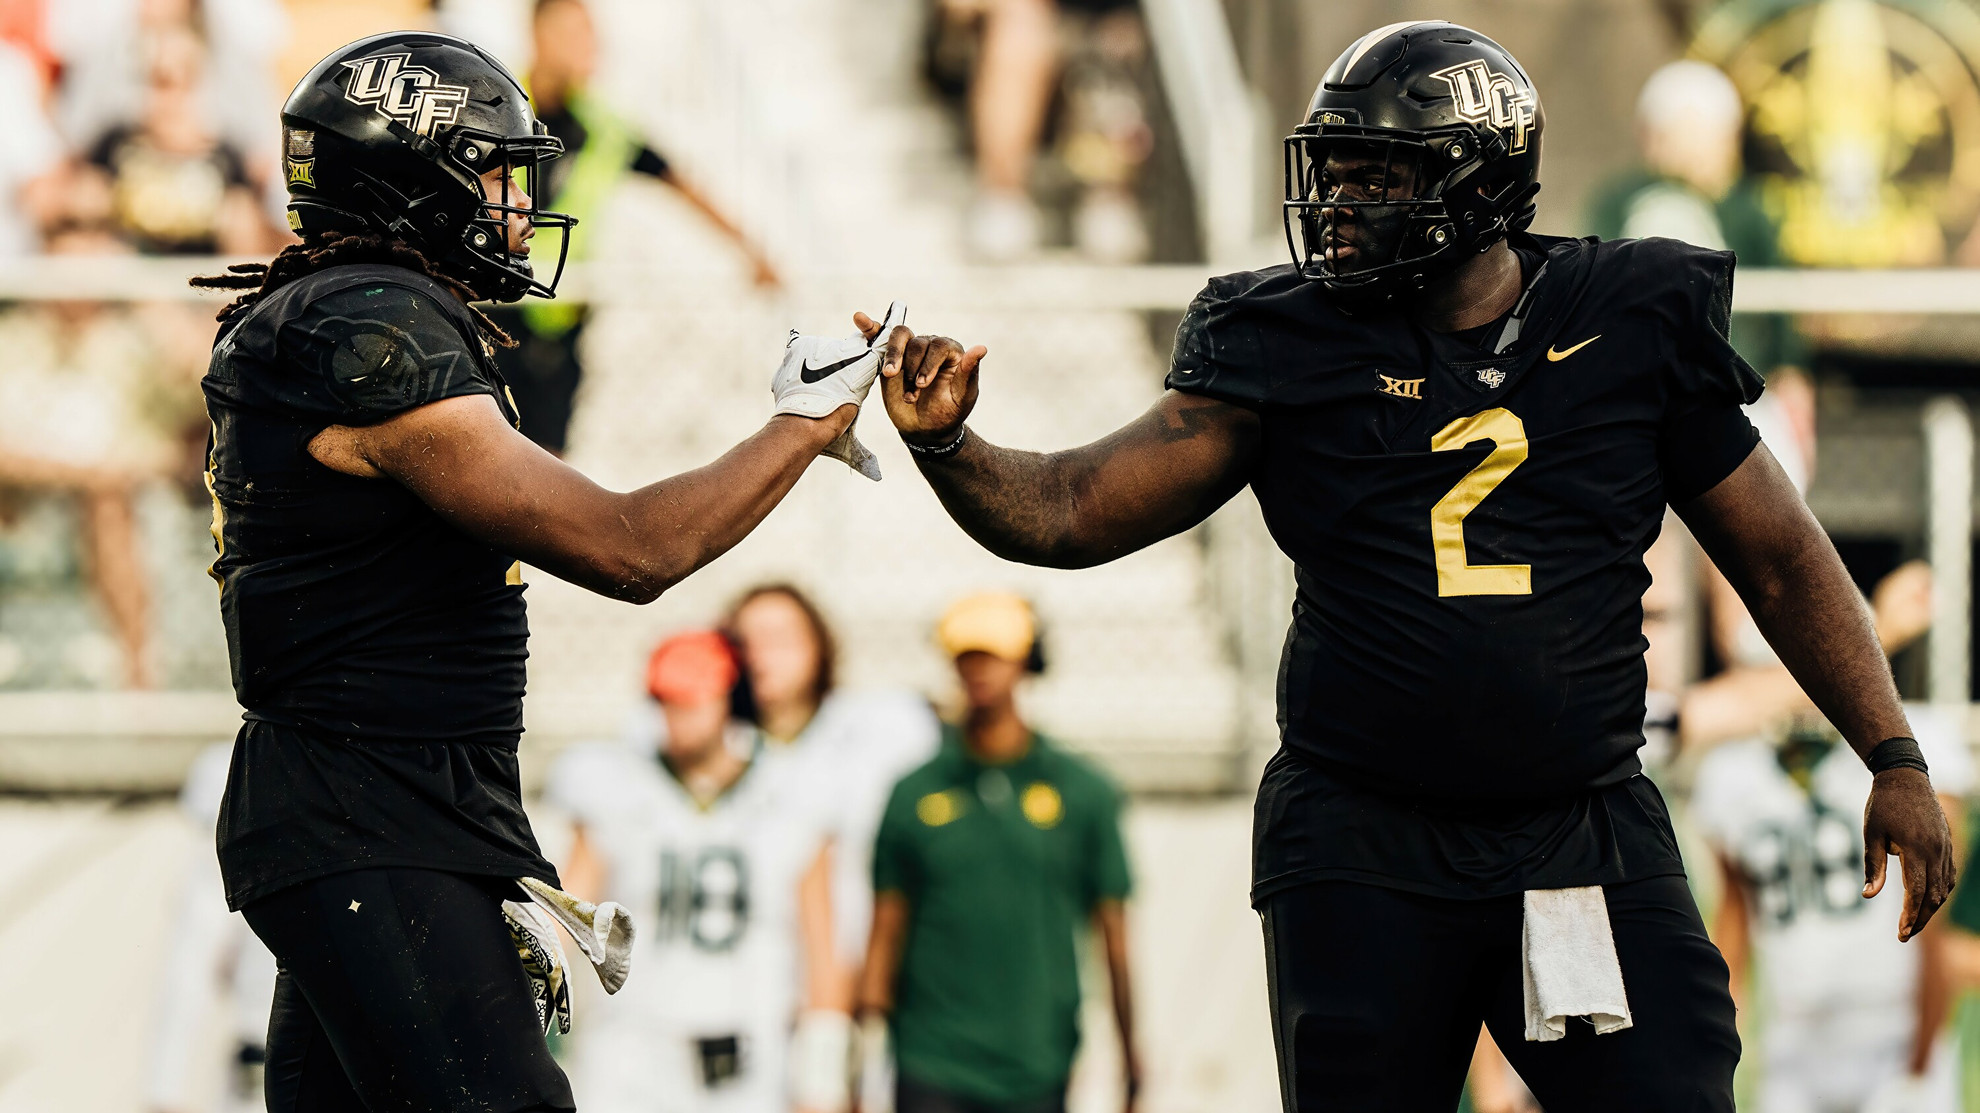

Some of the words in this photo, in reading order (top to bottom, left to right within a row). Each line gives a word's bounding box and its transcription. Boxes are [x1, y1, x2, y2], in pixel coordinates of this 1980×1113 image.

[340, 53, 469, 143] UCF
[1429, 59, 1536, 156] UCF
[287, 157, 314, 186] XII
[1378, 373, 1426, 400] XII
[1476, 367, 1506, 389] UCF
[1431, 407, 1532, 597] 2
